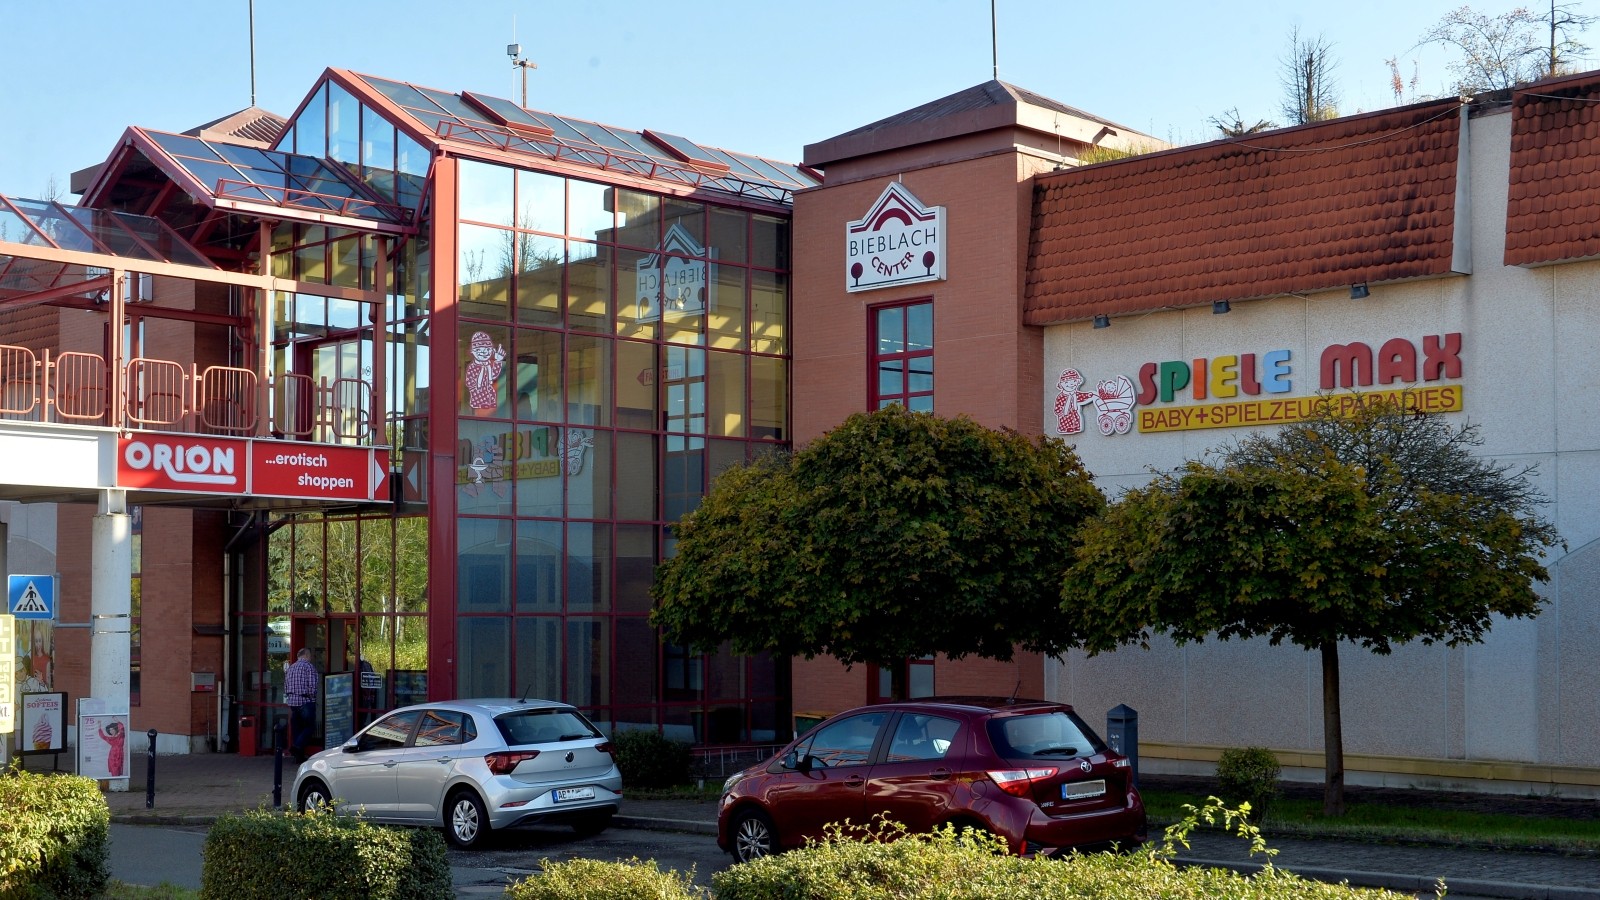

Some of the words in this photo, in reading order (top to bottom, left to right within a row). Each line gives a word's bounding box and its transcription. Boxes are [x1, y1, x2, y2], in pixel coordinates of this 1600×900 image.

[850, 227, 936, 257] BIEBLACH
[871, 251, 915, 277] CENTER
[1137, 349, 1291, 406] SPIELE
[1319, 332, 1462, 390] MAX
[125, 441, 237, 485] ORION
[265, 452, 328, 468] ...erotisch
[297, 472, 354, 490] shoppen
[26, 701, 59, 709] SOFTEIS
